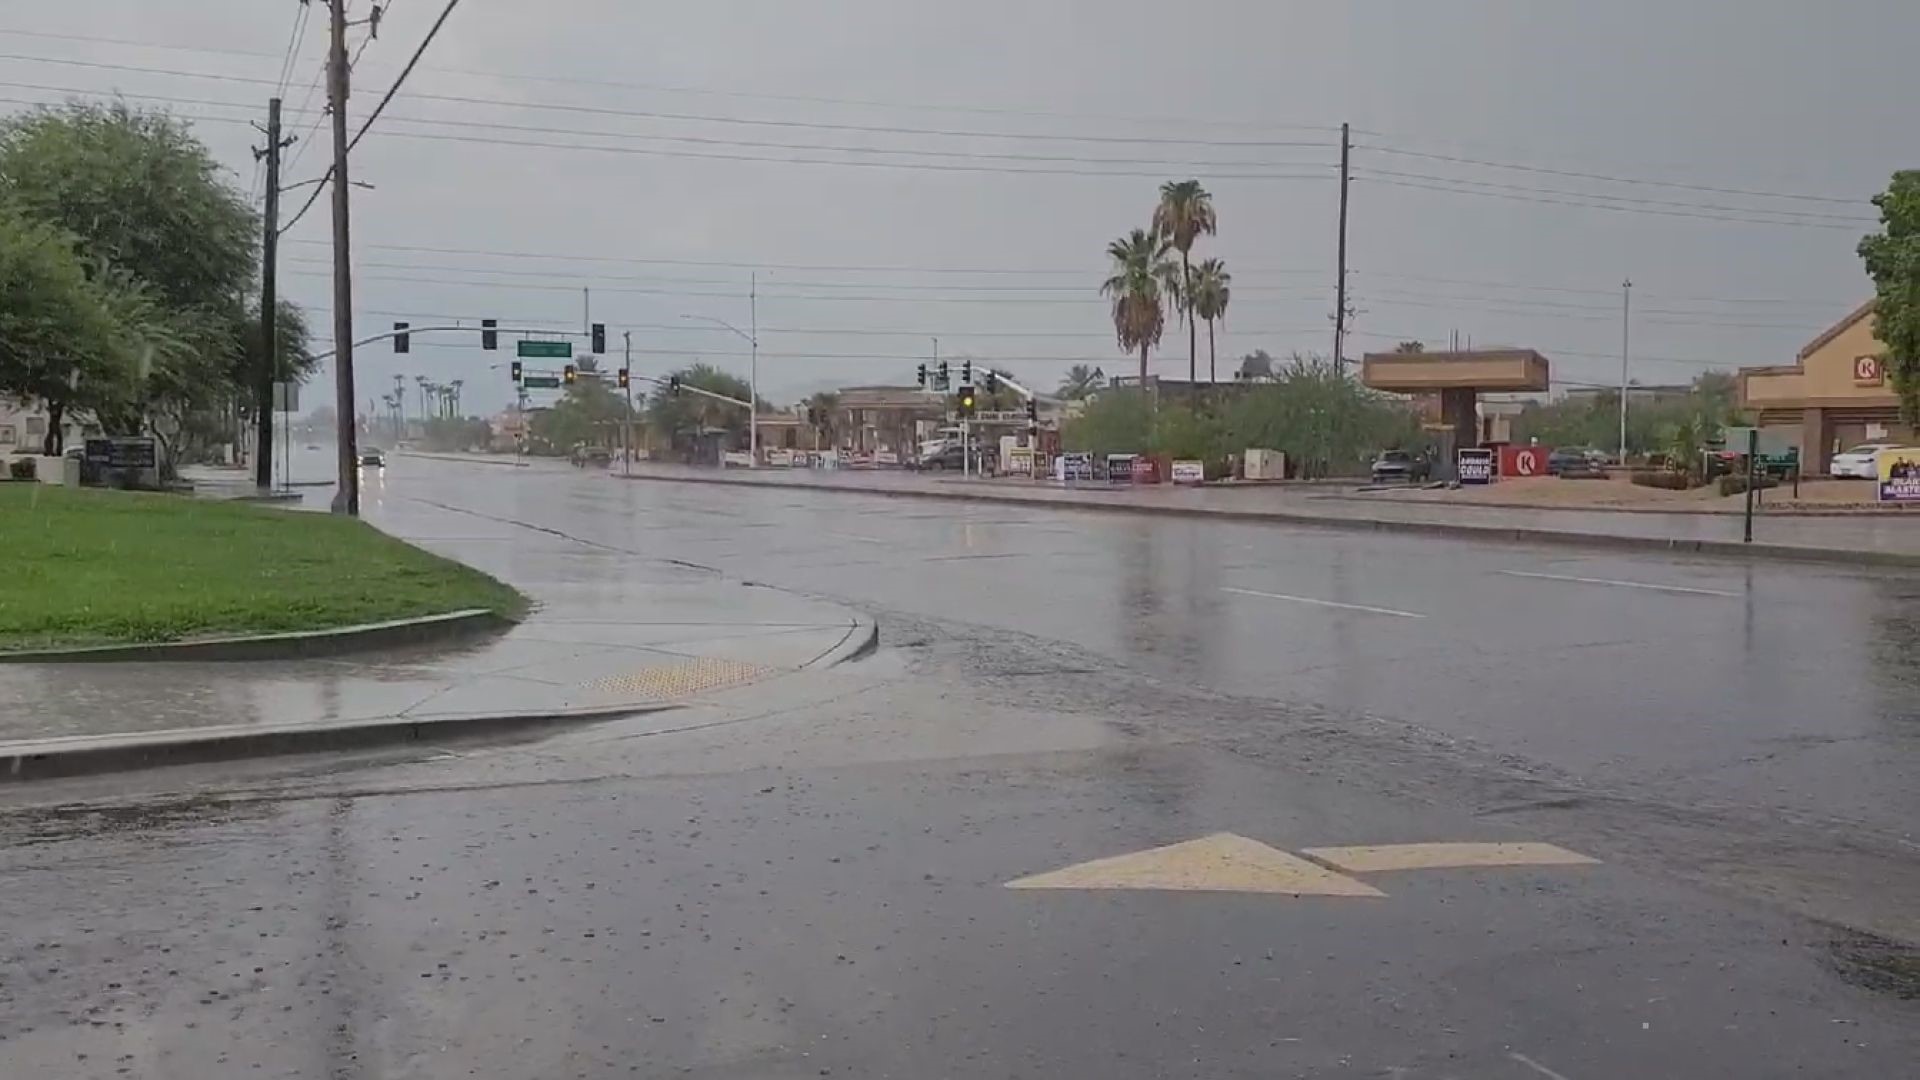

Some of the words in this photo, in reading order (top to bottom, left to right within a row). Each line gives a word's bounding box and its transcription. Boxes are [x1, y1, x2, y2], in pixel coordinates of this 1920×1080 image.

[1862, 362, 1874, 377] K
[1521, 455, 1534, 475] K
[1882, 485, 1920, 494] MASTE
